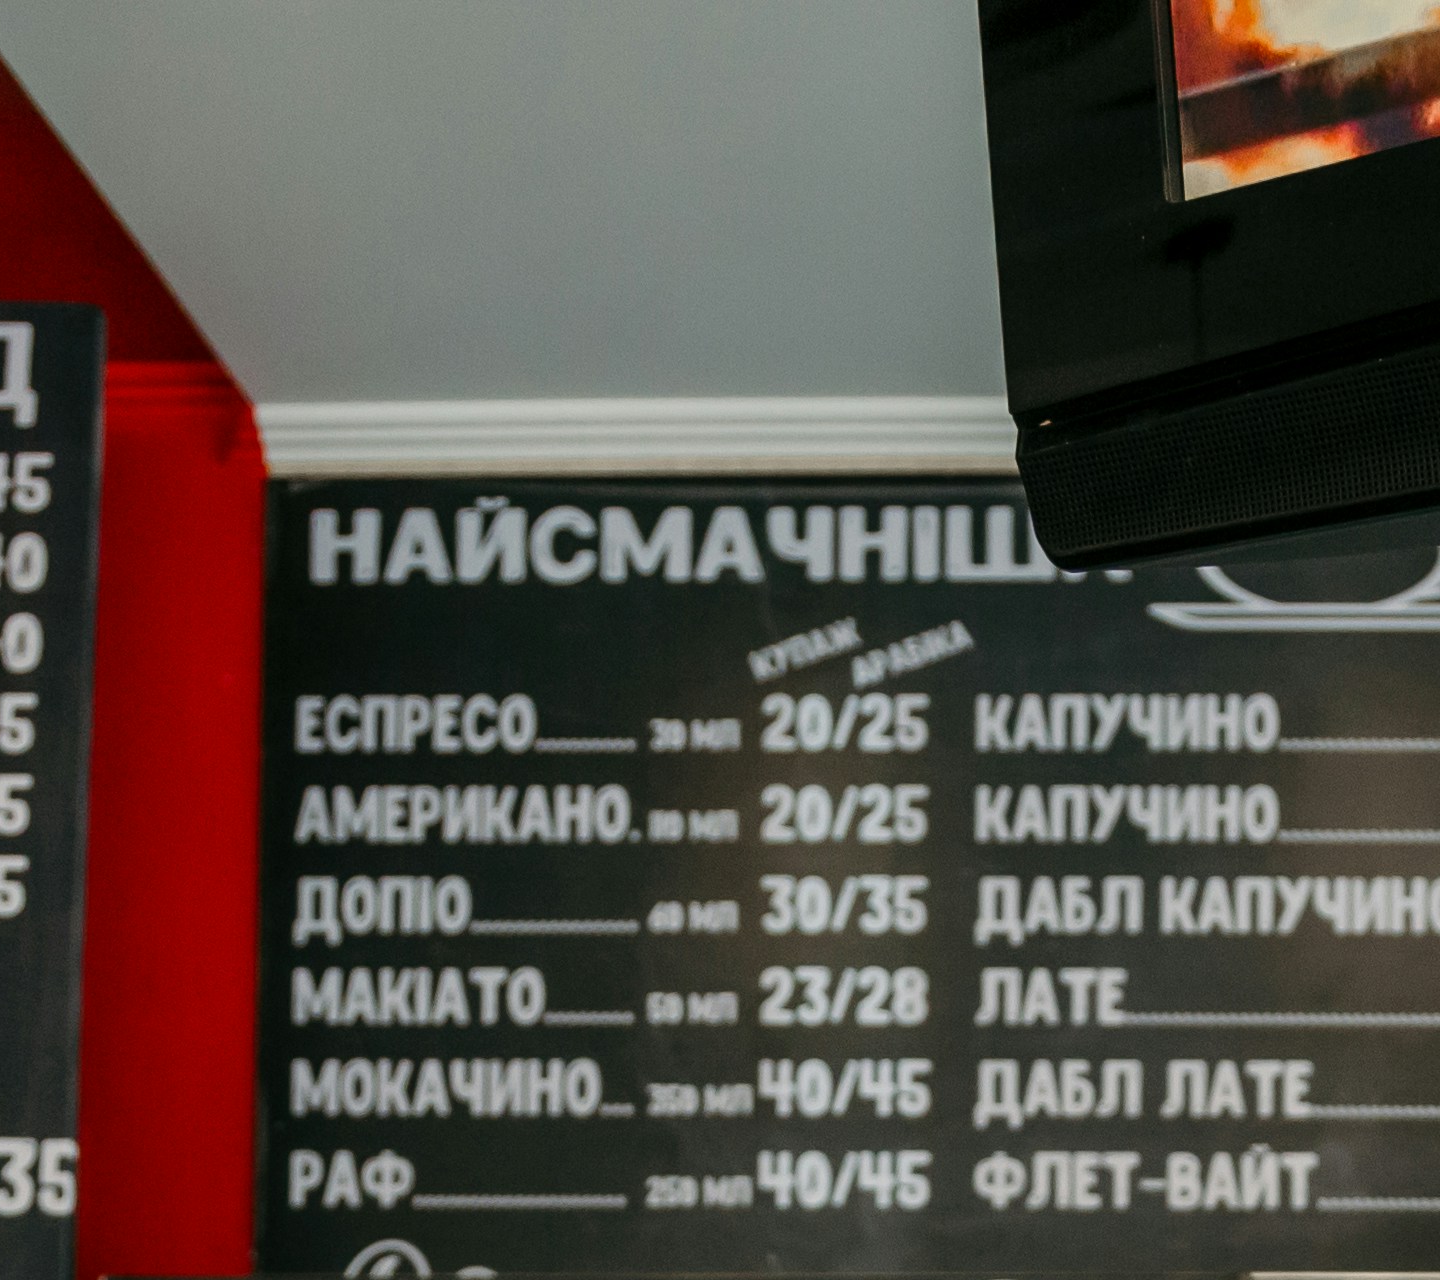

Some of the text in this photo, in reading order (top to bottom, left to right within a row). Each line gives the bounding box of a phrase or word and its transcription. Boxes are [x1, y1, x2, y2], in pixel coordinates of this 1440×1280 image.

[309, 497, 1134, 585] НАЙСМАЧНІШ
[293, 692, 931, 754] ЕСПРЕСО 20/25
[974, 692, 1281, 753] КАПУЧИНО
[760, 784, 931, 844] 20/25
[973, 783, 1281, 844] КАПУЧИНО
[291, 874, 930, 946] ДОПІО 30/35
[974, 874, 1144, 946] ДАБЛ
[291, 965, 930, 1027] МАКІАТО 23/28
[973, 966, 1127, 1029] ЛАТЕ
[288, 1057, 934, 1119] МОКАЧИНО 40/45
[973, 1058, 1144, 1131] ДАБЛ
[1161, 1058, 1314, 1121] ЛАТЕ
[287, 1148, 934, 1210] РАФ 40/45
[972, 1143, 1320, 1213] ФЛЕТ-ВАЙТ
